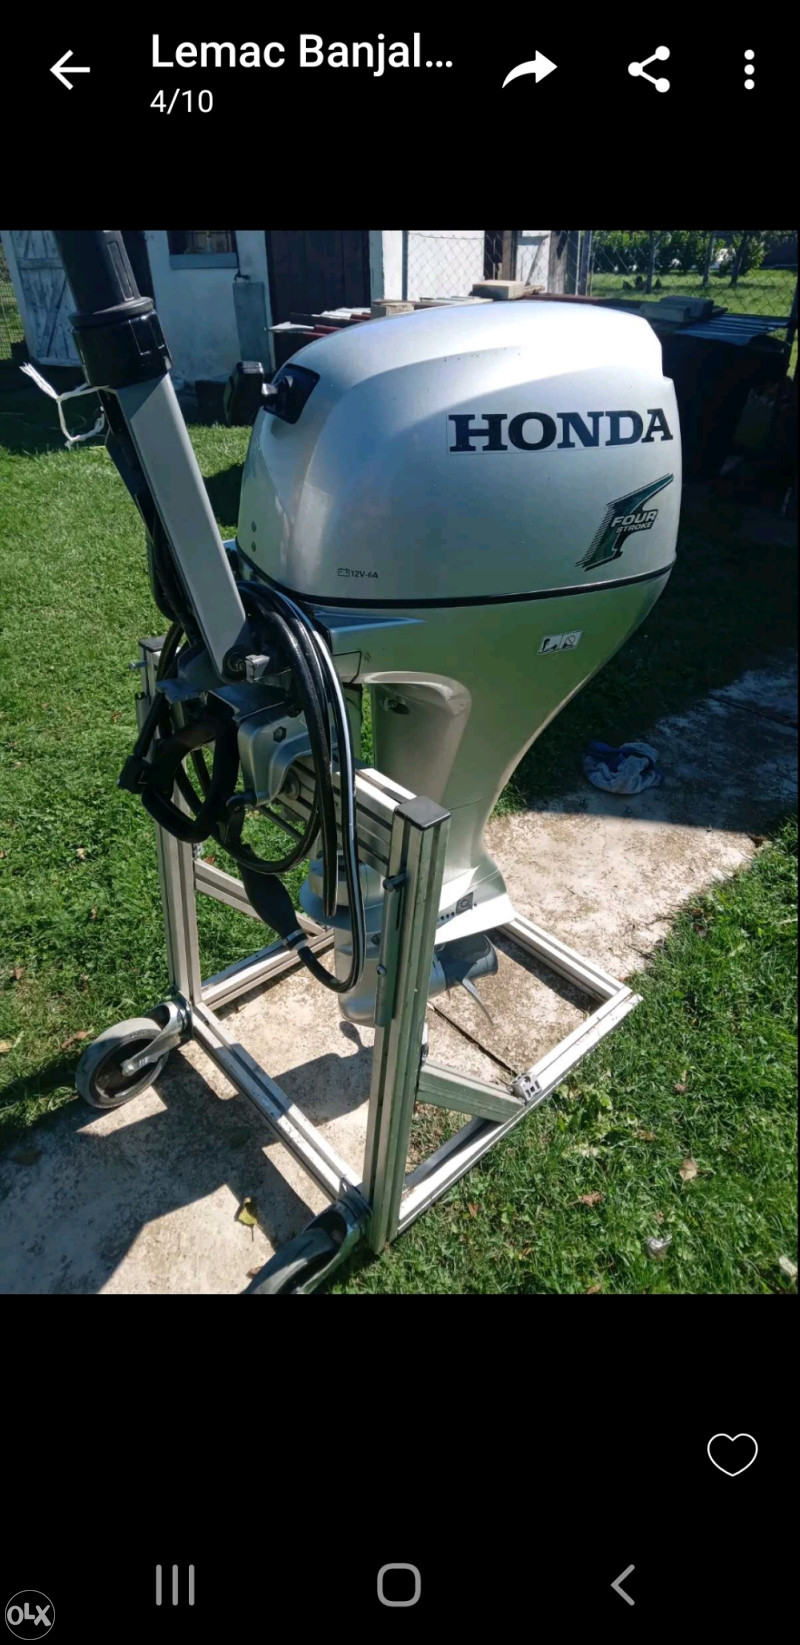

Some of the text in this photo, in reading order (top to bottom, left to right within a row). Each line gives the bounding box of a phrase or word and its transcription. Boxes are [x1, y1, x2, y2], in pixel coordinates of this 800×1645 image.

[448, 408, 673, 452] HONDA
[611, 511, 657, 527] FOUR
[616, 521, 653, 533] STROKE
